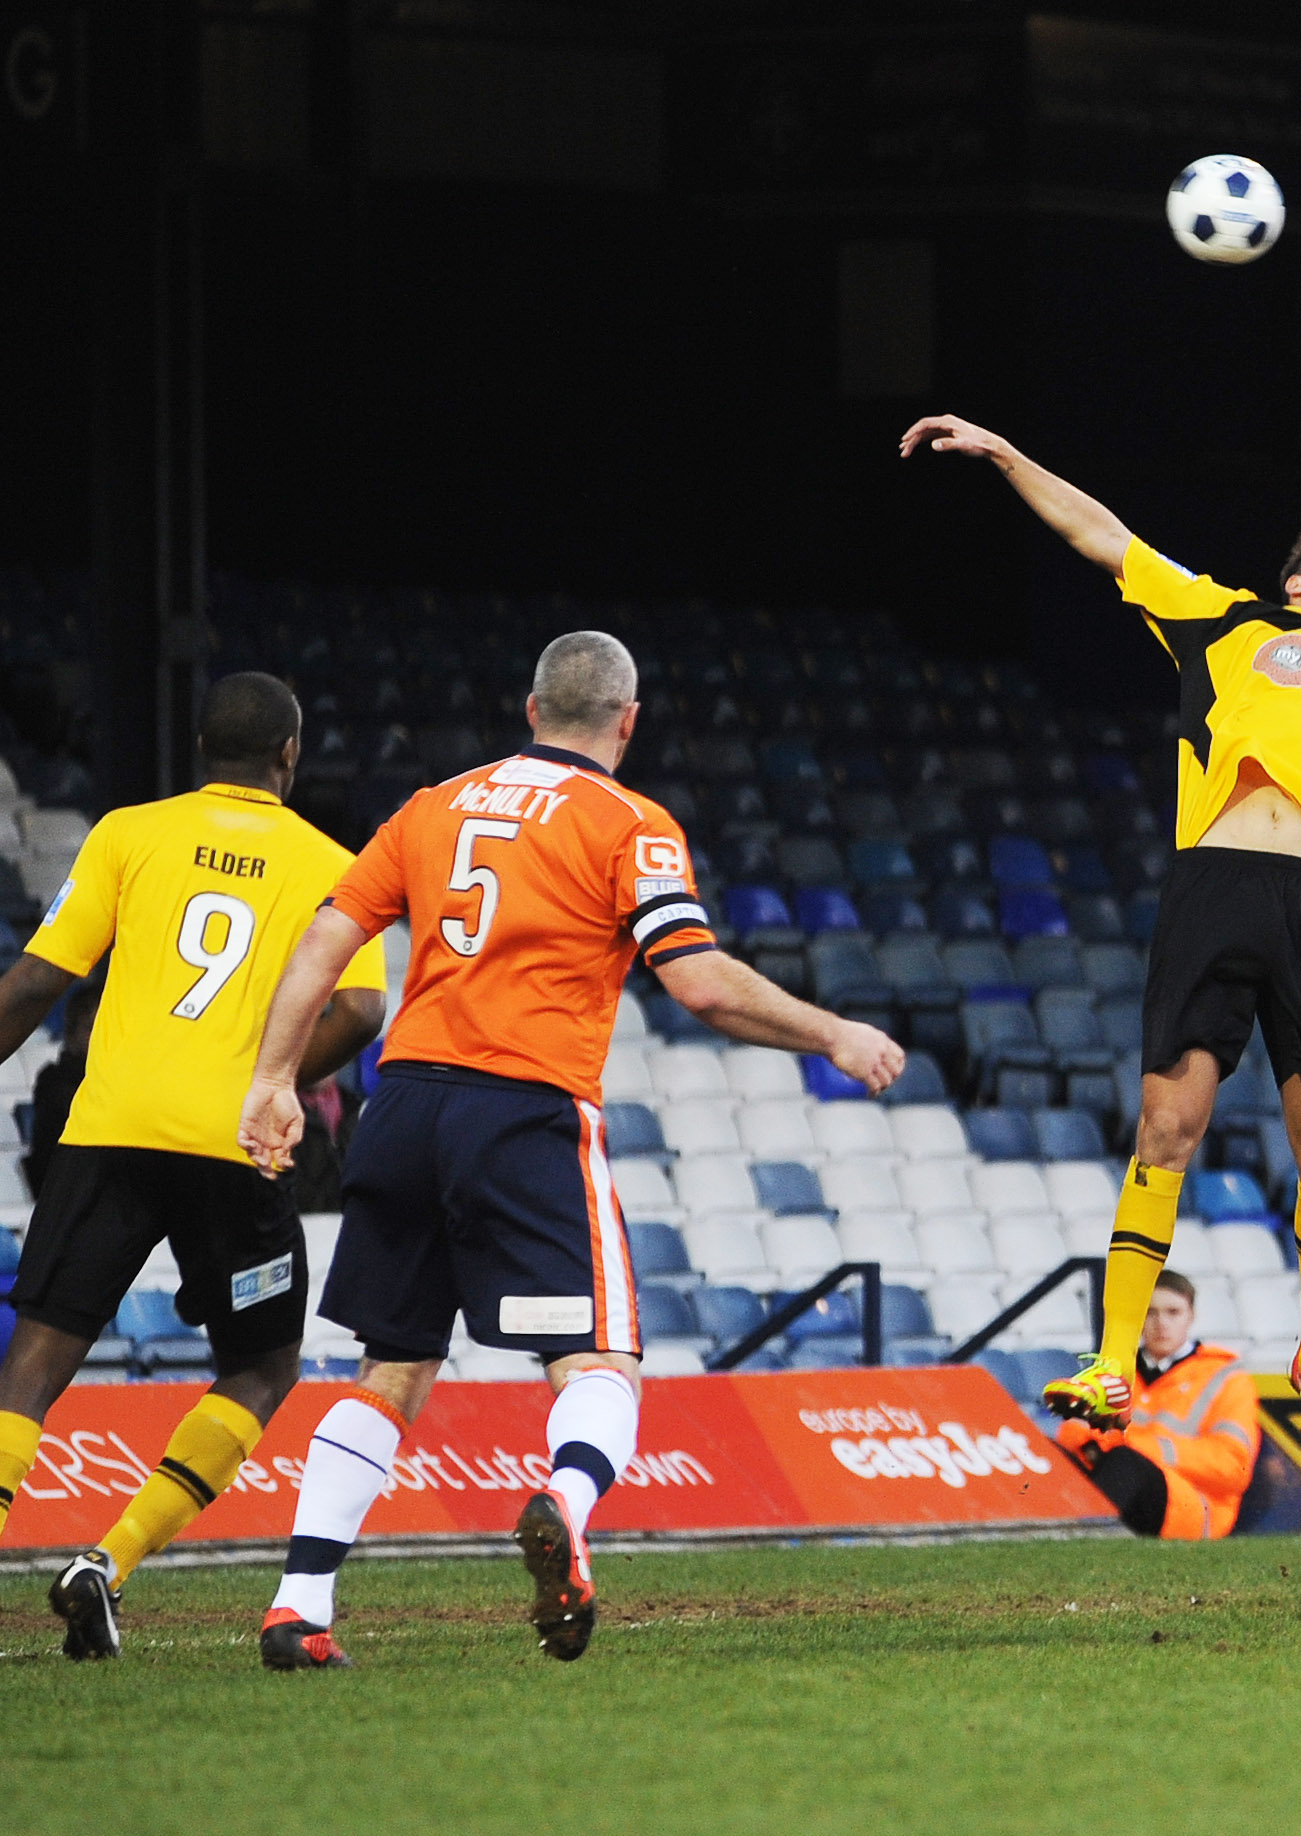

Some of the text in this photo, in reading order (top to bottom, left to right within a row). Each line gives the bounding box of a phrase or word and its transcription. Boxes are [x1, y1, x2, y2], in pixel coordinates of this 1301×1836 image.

[194, 846, 266, 879] ELDER
[440, 816, 522, 958] 5
[170, 890, 256, 1021] 9
[799, 1400, 927, 1436] europe by
[441, 1443, 555, 1490] Luto
[614, 1449, 715, 1488] own
[830, 1421, 1051, 1488] easyJet
